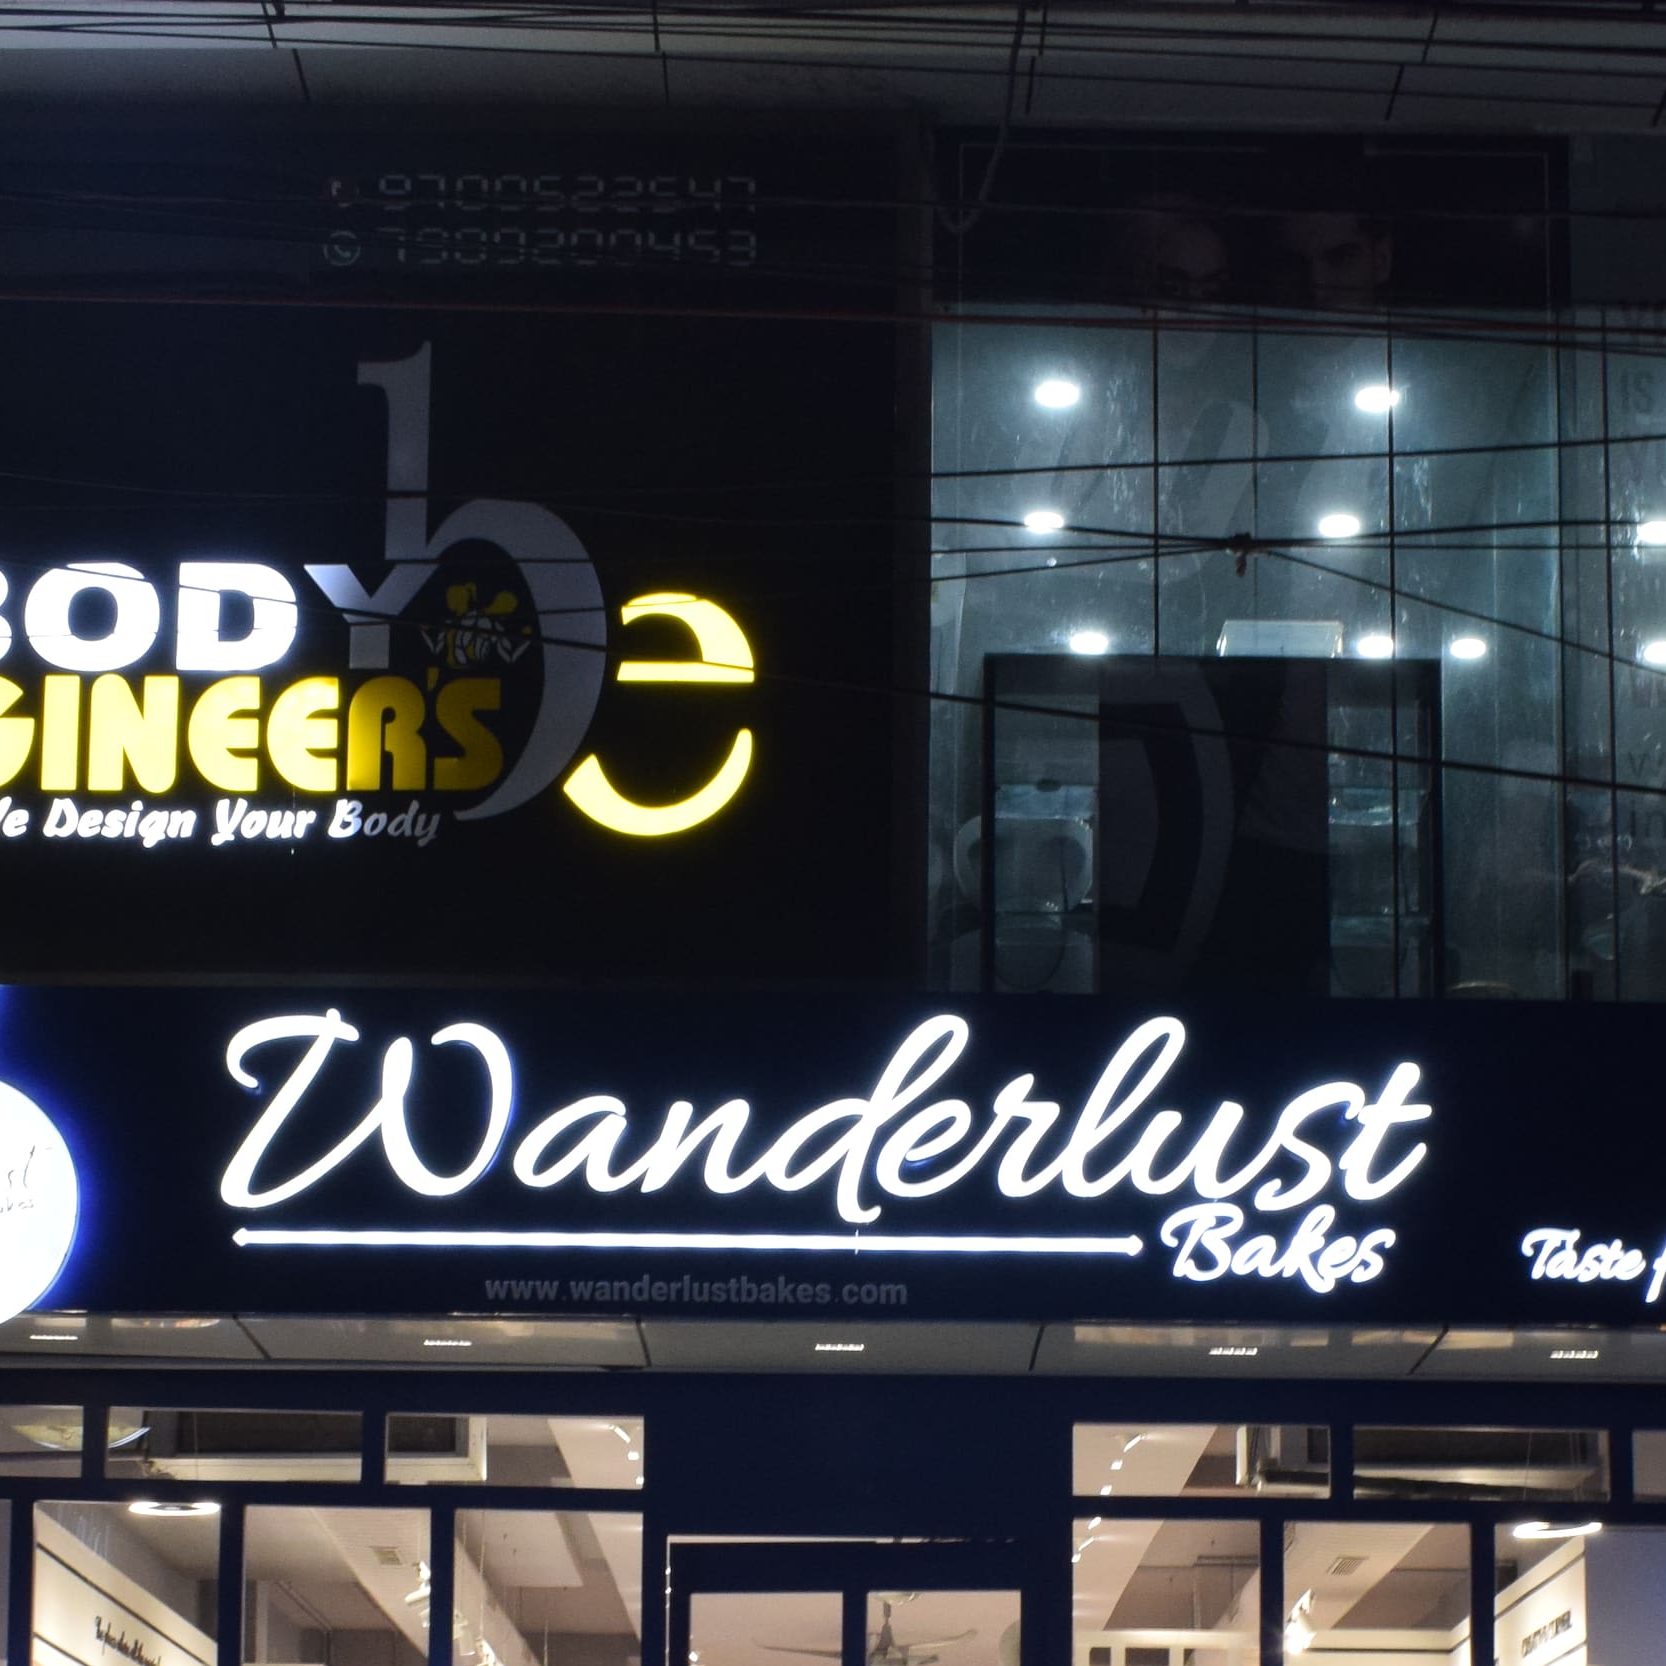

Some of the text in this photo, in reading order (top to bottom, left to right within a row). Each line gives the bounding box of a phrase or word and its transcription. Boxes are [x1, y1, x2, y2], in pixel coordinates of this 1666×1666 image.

[42, 797, 197, 849] Design
[210, 797, 317, 849] Your
[328, 796, 441, 849] Body
[219, 1006, 1434, 1228] Wanderlust
[1159, 1201, 1399, 1295] Bakes
[1521, 1227, 1645, 1283] Taste
[484, 1273, 910, 1305] www.wanderlustbakes.com
